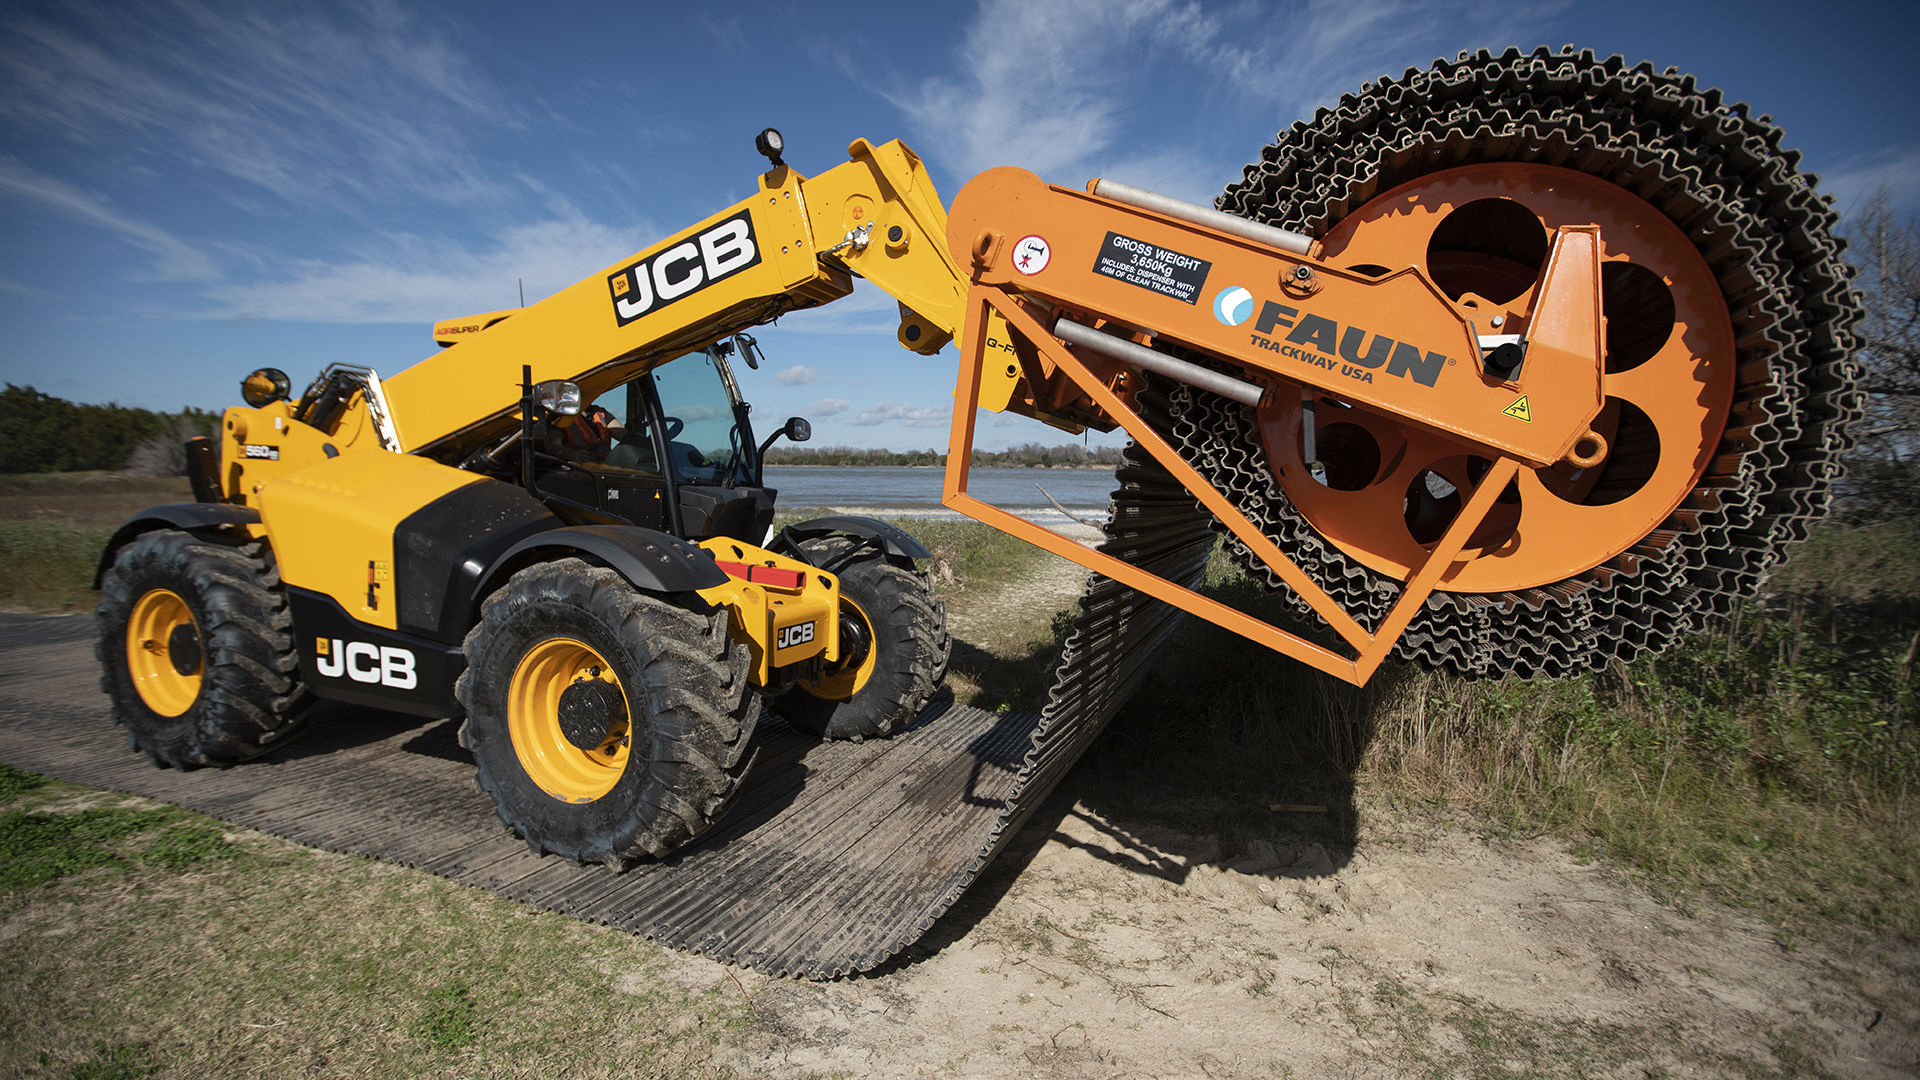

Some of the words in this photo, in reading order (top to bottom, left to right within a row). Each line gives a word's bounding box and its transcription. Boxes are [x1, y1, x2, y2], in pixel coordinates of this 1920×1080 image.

[617, 219, 755, 318] JCB
[1113, 236, 1152, 256] GROSS
[1156, 249, 1201, 271] WEIGHT
[1130, 254, 1173, 277] 3,650Kg
[1101, 257, 1136, 274] INCLUDES:
[1137, 268, 1176, 286] DISPENSER
[1176, 281, 1195, 292] WITH
[1101, 265, 1114, 276] 40M
[1115, 270, 1125, 278] OF
[1126, 273, 1150, 287] CLEAN
[1151, 281, 1190, 299] TRACKWAY
[1250, 334, 1338, 371] TRACKWAY
[1341, 364, 1374, 385] USA
[778, 622, 814, 648] JCB
[317, 639, 417, 690] JCB
